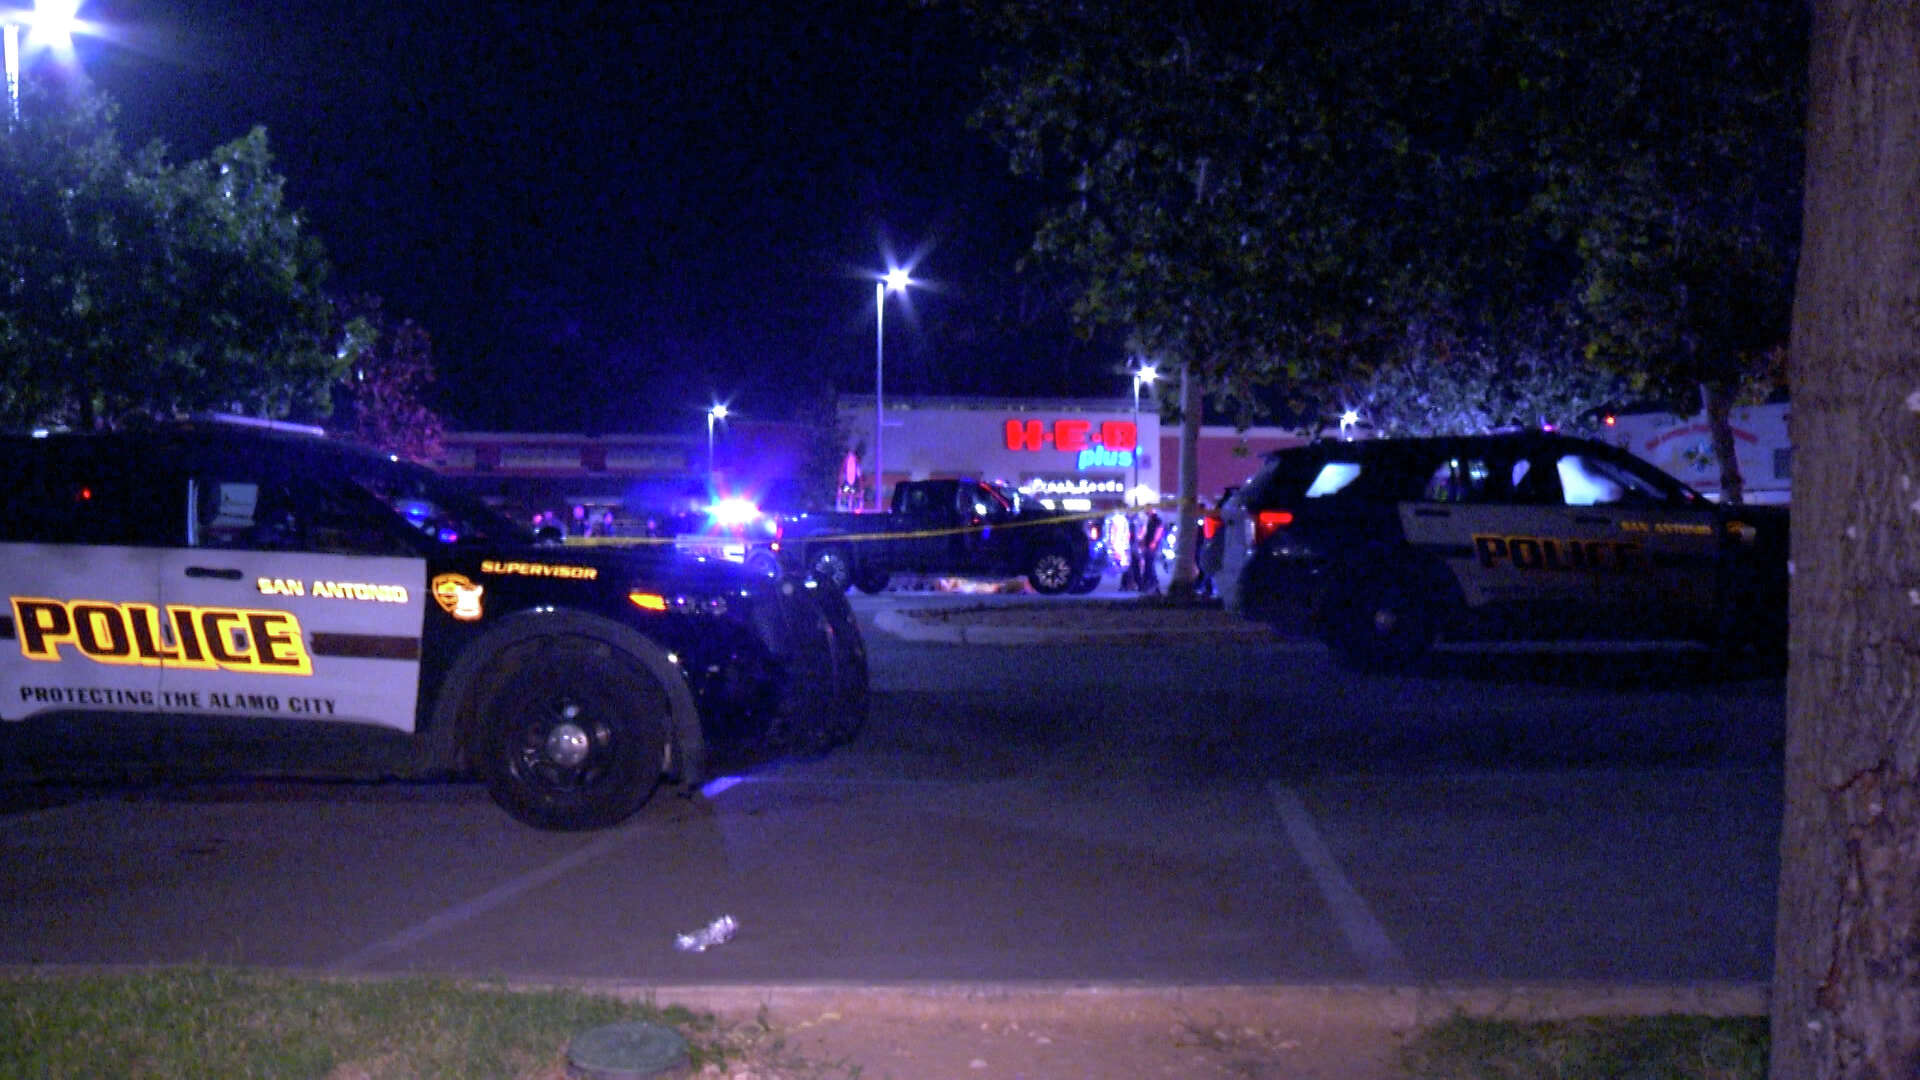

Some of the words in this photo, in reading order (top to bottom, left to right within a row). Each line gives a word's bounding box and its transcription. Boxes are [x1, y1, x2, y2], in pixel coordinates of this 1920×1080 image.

[1078, 445, 1132, 470] plus
[1079, 479, 1124, 493] Foods
[1621, 521, 1648, 531] SAN
[1473, 534, 1644, 569] POLICE
[481, 560, 598, 580] SUPERVISOR
[258, 577, 305, 597] SAN
[312, 580, 409, 604] ANTONIO
[11, 596, 314, 676] POLICE
[20, 686, 153, 705] PROTECTING
[162, 691, 199, 709] THE
[209, 693, 279, 712] ALAMO
[289, 696, 336, 715] CITY
